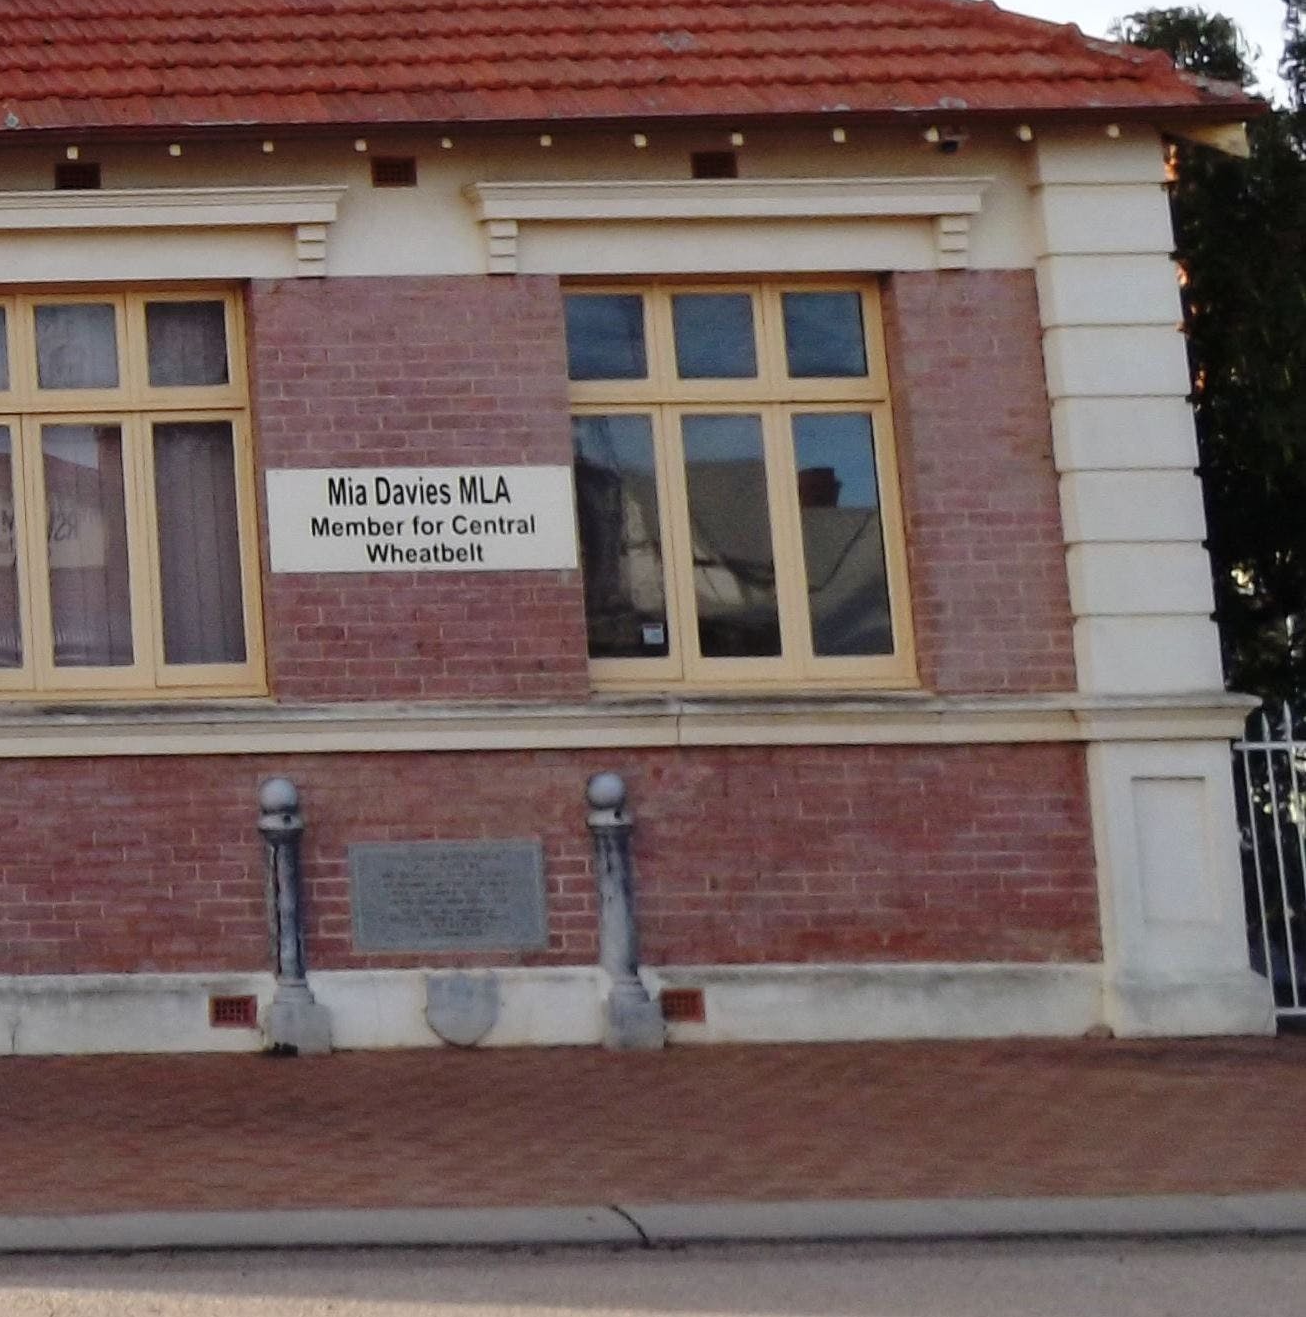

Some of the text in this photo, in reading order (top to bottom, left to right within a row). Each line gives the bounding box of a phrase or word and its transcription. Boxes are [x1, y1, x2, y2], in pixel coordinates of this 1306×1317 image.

[327, 475, 511, 506] Mia Davies MLA
[310, 514, 536, 537] Member for Central
[365, 542, 484, 563] Wheatbelt
